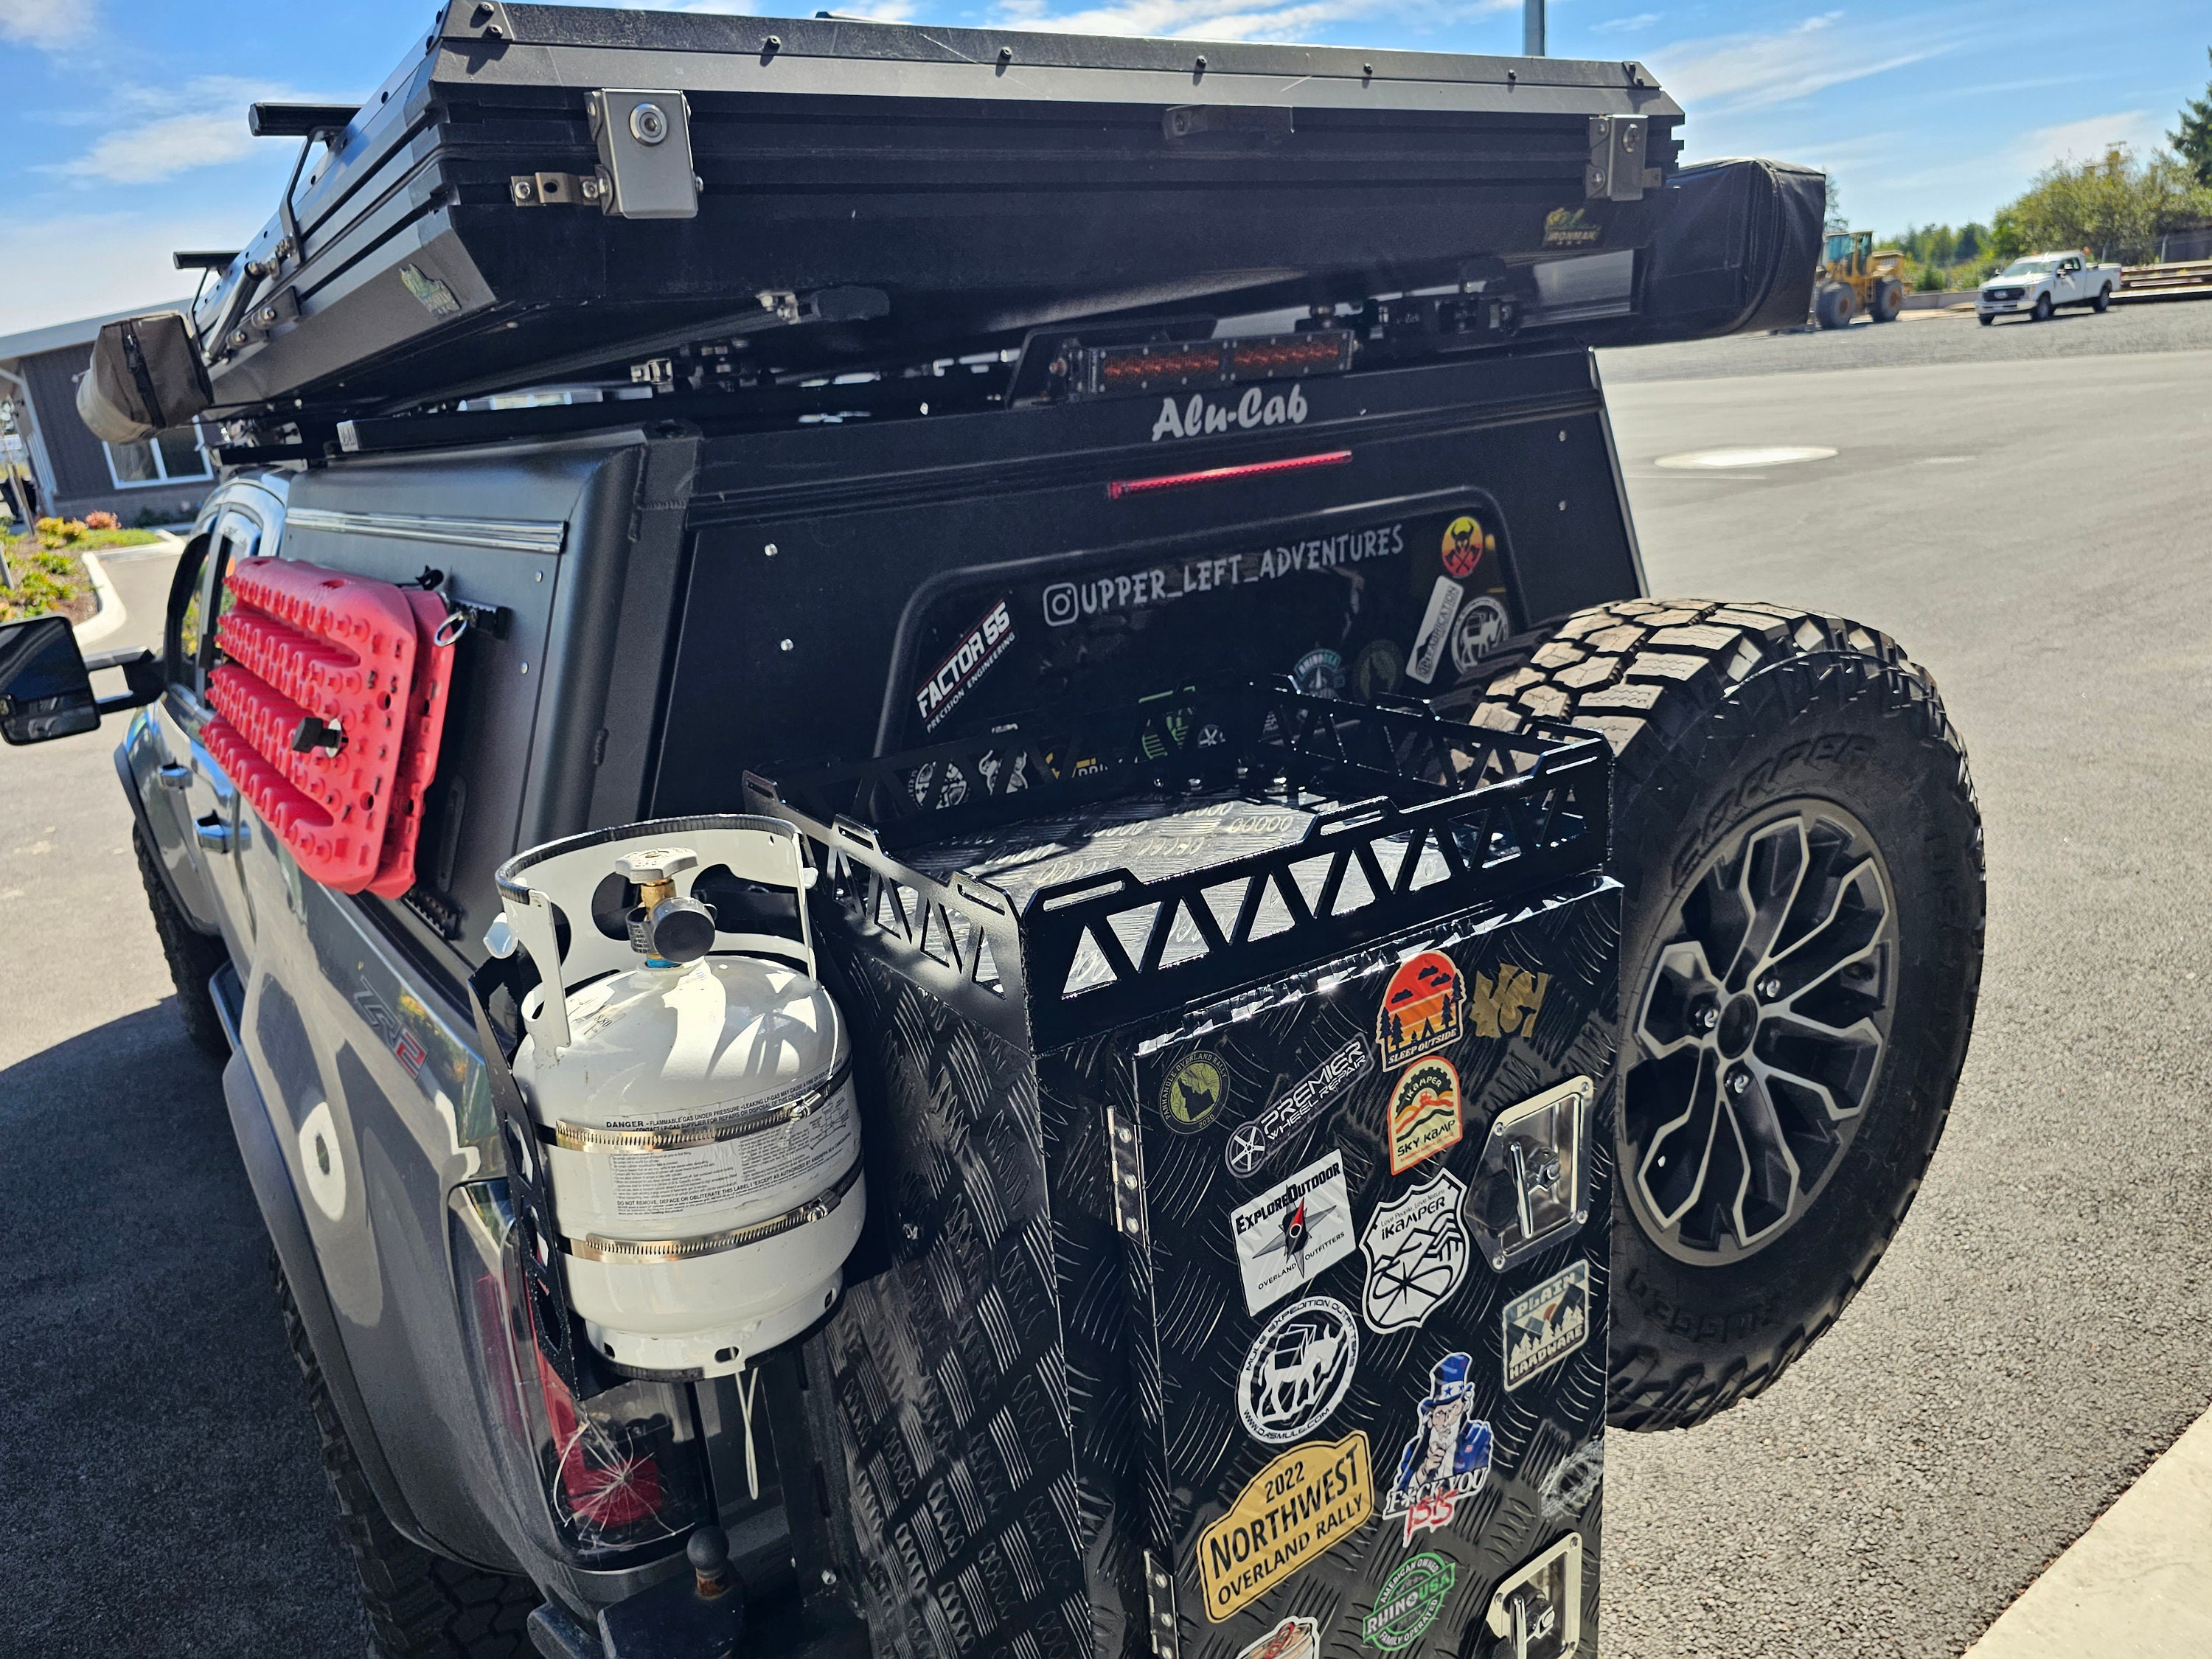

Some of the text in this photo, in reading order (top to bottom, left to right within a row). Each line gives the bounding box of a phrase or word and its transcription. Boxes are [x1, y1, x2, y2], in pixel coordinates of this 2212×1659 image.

[1152, 383, 1308, 442] Alu-Cab
[1081, 524, 1404, 614] UPPER_LEFT_ADVENTURES
[917, 631, 985, 719] FACTOR
[982, 601, 1010, 646] 55
[926, 689, 965, 734] PRECISION
[966, 632, 1016, 689] ENGINEERING
[1388, 1028, 1457, 1064] SLEEP OUTSIDE
[650, 1116, 681, 1126] FLAMMABLE
[695, 1112, 713, 1121] UNDER
[713, 1105, 740, 1116] PRESSURE
[743, 1097, 764, 1109] LEAKING
[1161, 1053, 1227, 1120] PANHANDLE OVERLAND RALLY
[1261, 1041, 1363, 1135] PREMIER
[1267, 1054, 1366, 1141] WHEEL REPAIR
[681, 1119, 706, 1129] SUPPLIER
[718, 1112, 740, 1121] REPAIRS
[748, 1104, 770, 1114] DISPOSAL
[1198, 1114, 1215, 1128] 2020
[1397, 1137, 1420, 1157] SKY
[1423, 1119, 1456, 1144] KAMP
[689, 1190, 720, 1200] OBLITERATE
[734, 1183, 750, 1192] LABEL
[1380, 1216, 1395, 1227] Love
[1414, 1197, 1427, 1209] Love
[1427, 1189, 1446, 1202] Nature
[1258, 1231, 1346, 1290] OVERLAND OUTFITTERS
[1516, 1272, 1576, 1318] PLAIN
[1246, 1298, 1358, 1371] MULE EXPEDITION OUTFITTERS
[1509, 1324, 1583, 1380] HARDWARE
[1244, 1408, 1330, 1439] WWW.DASMULE.COM
[1265, 1460, 1305, 1503] 2022
[1450, 1467, 1488, 1494] YOU
[1209, 1443, 1358, 1579] NORTHWEST
[1218, 1492, 1363, 1605] OVERLAND RALLY
[1366, 1591, 1419, 1635] RHINO
[1418, 1573, 1450, 1600] USA
[1380, 1558, 1440, 1603] AMERICAN OWNED
[1379, 1630, 1403, 1645] FAMILY
[1403, 1599, 1439, 1642] OPERATED
